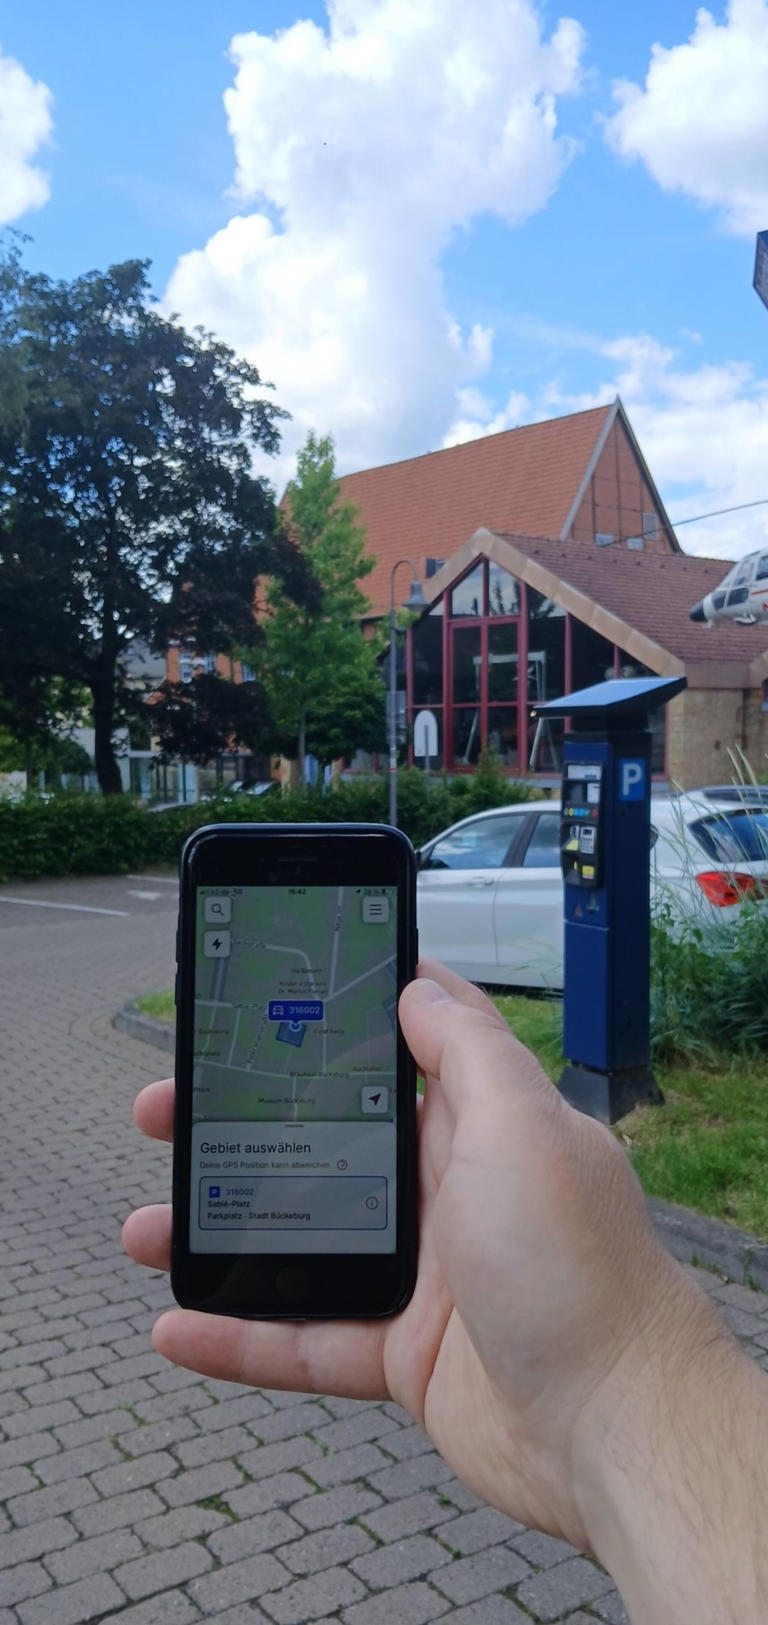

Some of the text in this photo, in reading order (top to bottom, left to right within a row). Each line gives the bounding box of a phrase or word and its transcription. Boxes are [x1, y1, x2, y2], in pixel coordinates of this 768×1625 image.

[622, 763, 642, 796] P
[289, 1006, 320, 1014] 316002
[200, 1142, 311, 1154] Gebiet auswählen
[226, 1188, 254, 1196] 316002
[207, 1212, 242, 1221] Parkplatz
[248, 1212, 269, 1220] Stadt
[270, 1211, 311, 1221] Bückeburg
